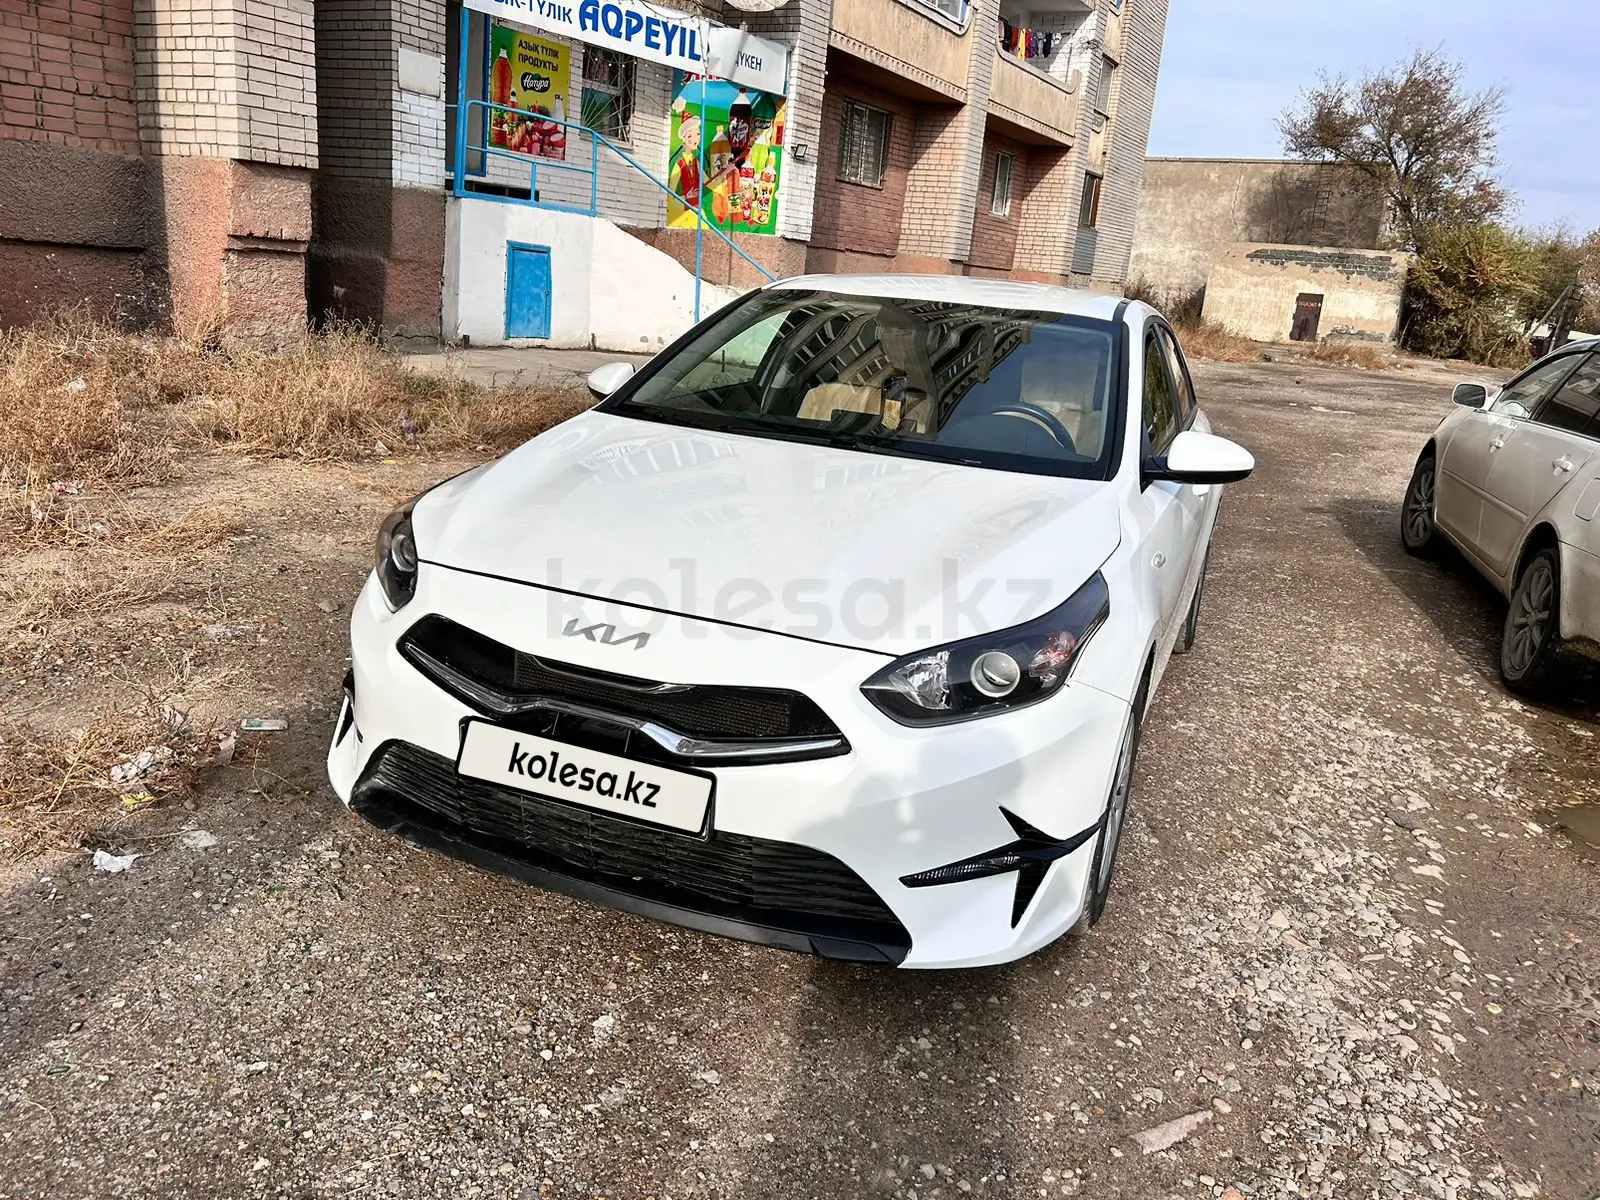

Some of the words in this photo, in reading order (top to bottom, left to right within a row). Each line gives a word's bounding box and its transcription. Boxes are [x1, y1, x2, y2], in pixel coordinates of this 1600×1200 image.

[579, 0, 701, 61] AQPEYIL
[518, 40, 540, 55] АЗЫҚ
[518, 53, 559, 73] ПРОДУКТЫ
